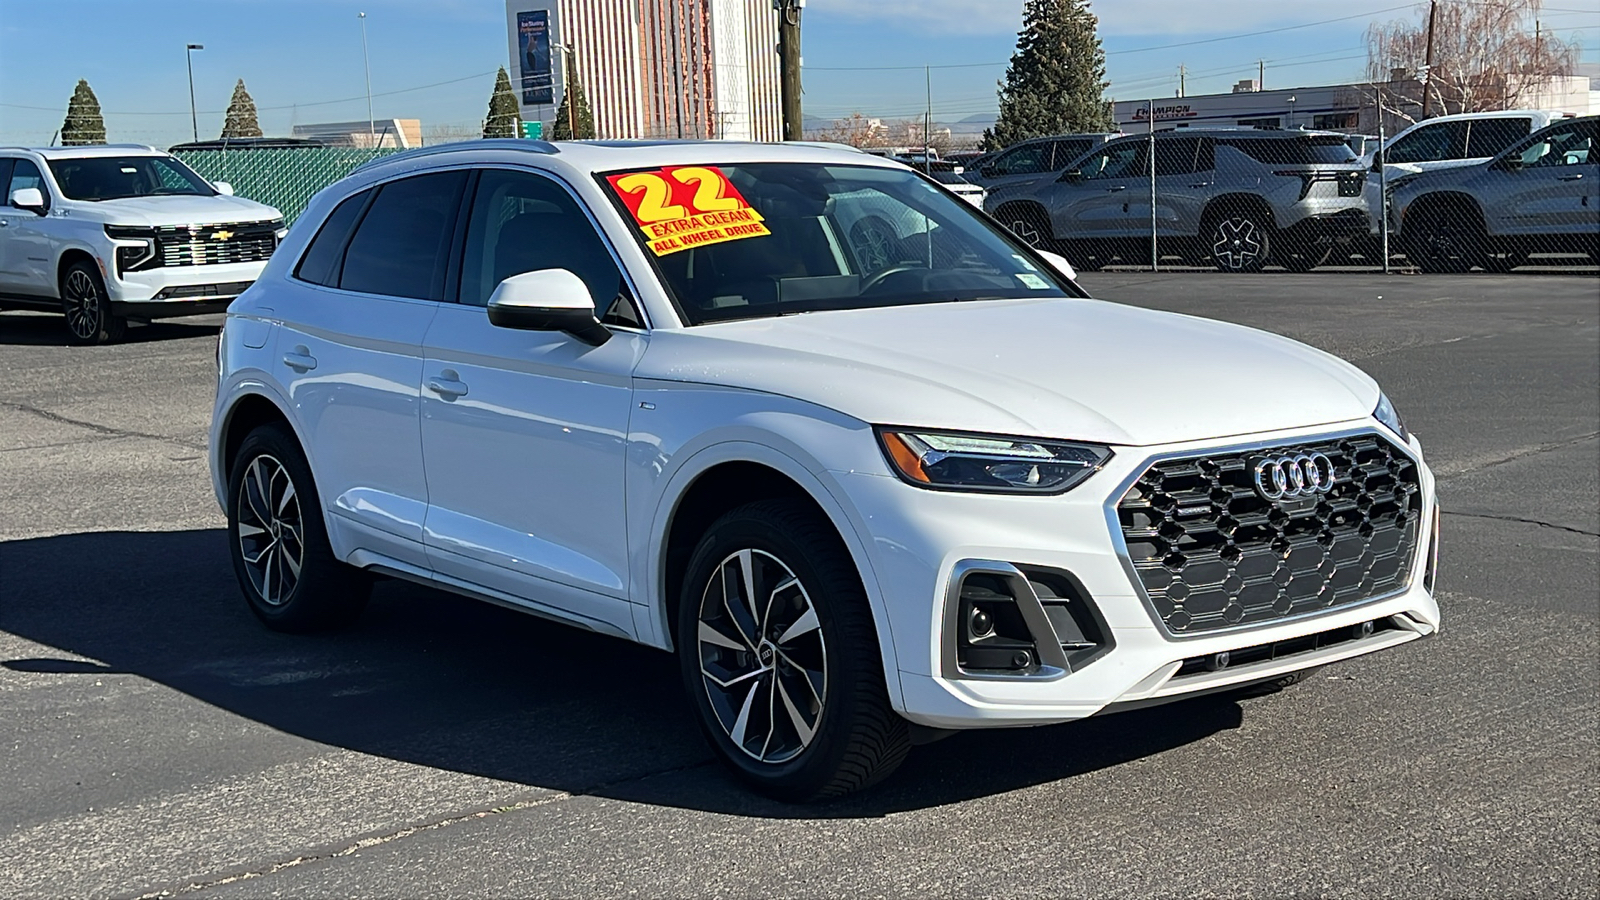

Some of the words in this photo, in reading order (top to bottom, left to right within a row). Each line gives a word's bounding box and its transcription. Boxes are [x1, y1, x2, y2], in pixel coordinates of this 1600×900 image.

[616, 166, 744, 223] 22
[650, 217, 704, 238] EXTRA
[702, 209, 753, 227] CLEAN
[653, 239, 681, 255] ALL
[679, 228, 725, 247] WHEEL
[725, 222, 765, 237] DRIVE
